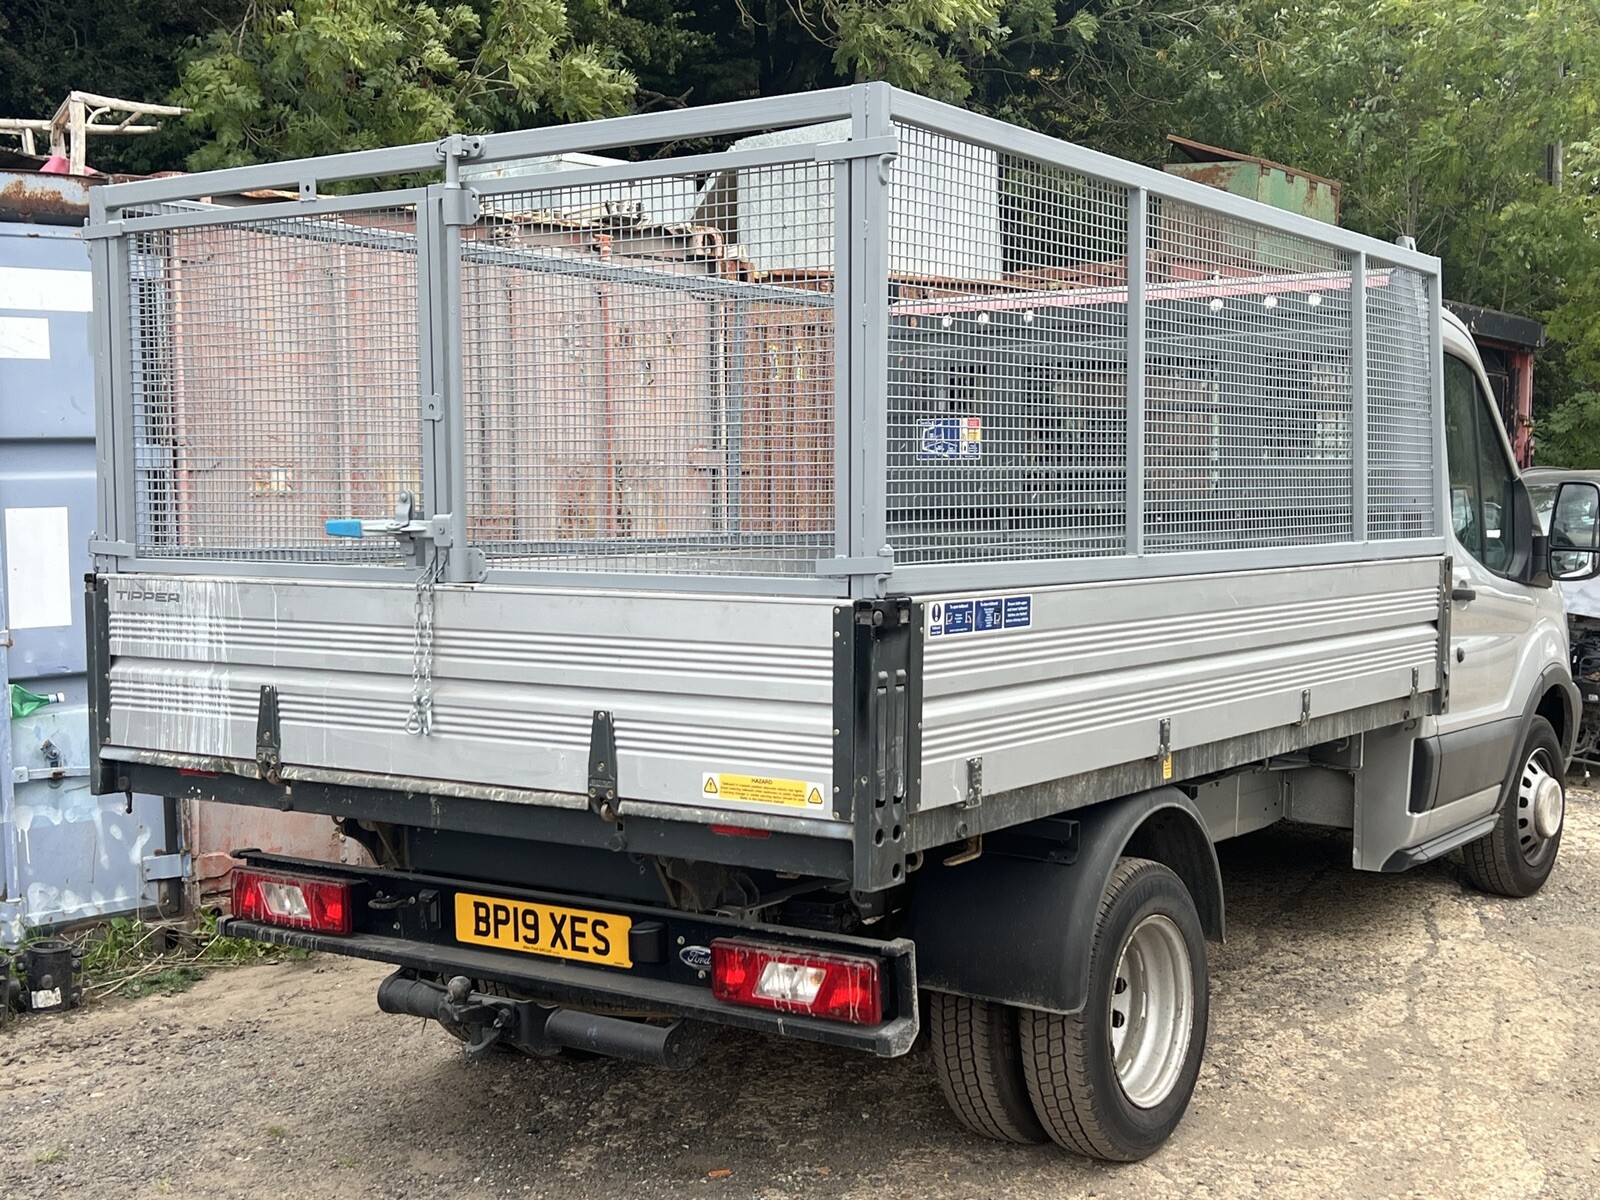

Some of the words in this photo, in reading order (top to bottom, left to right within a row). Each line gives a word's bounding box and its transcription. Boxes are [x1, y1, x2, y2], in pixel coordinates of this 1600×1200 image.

[116, 590, 181, 603] TIPPER
[473, 900, 540, 945] BP19
[549, 911, 611, 957] XES
[687, 949, 711, 965] Ford
